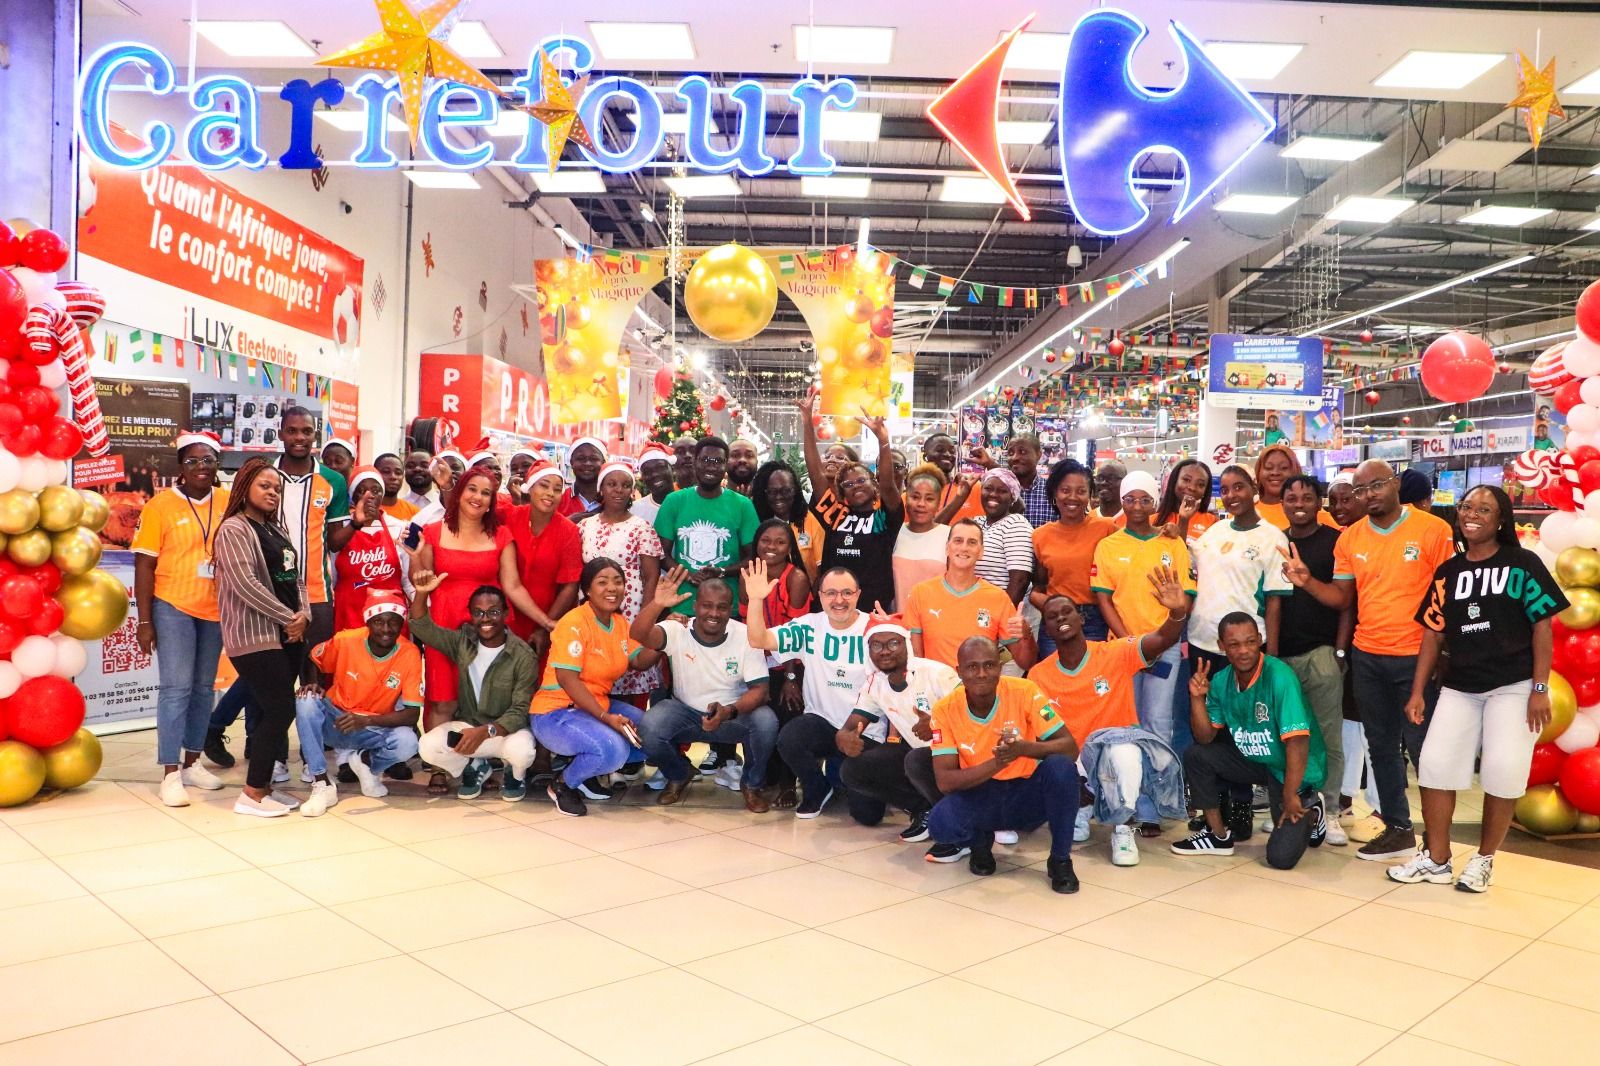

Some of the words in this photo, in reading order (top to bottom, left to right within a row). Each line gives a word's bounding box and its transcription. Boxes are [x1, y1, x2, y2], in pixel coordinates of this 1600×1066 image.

[78, 34, 858, 177] Carrefour
[141, 167, 216, 223] Quand
[217, 193, 292, 261] l'Afrique
[292, 233, 328, 282] joue,
[150, 209, 173, 254] le
[178, 231, 252, 286] confort
[255, 266, 313, 312] compte
[316, 285, 322, 313] !
[795, 252, 837, 272] Nël
[590, 287, 644, 301] Magique
[787, 281, 841, 298] Magique
[237, 330, 298, 367] Electronics
[1244, 338, 1285, 346] CARREFOUR
[102, 415, 120, 424] REZ
[122, 416, 132, 424] LE
[107, 425, 144, 436] ILLEUR
[147, 426, 171, 437] PRIX
[1423, 439, 1445, 453] TCL
[89, 472, 125, 481] COMMANDE
[348, 546, 387, 565] World
[361, 560, 395, 580] Cola
[1461, 621, 1491, 632] CHAMPIONS
[827, 680, 853, 690] CHAMPIONS
